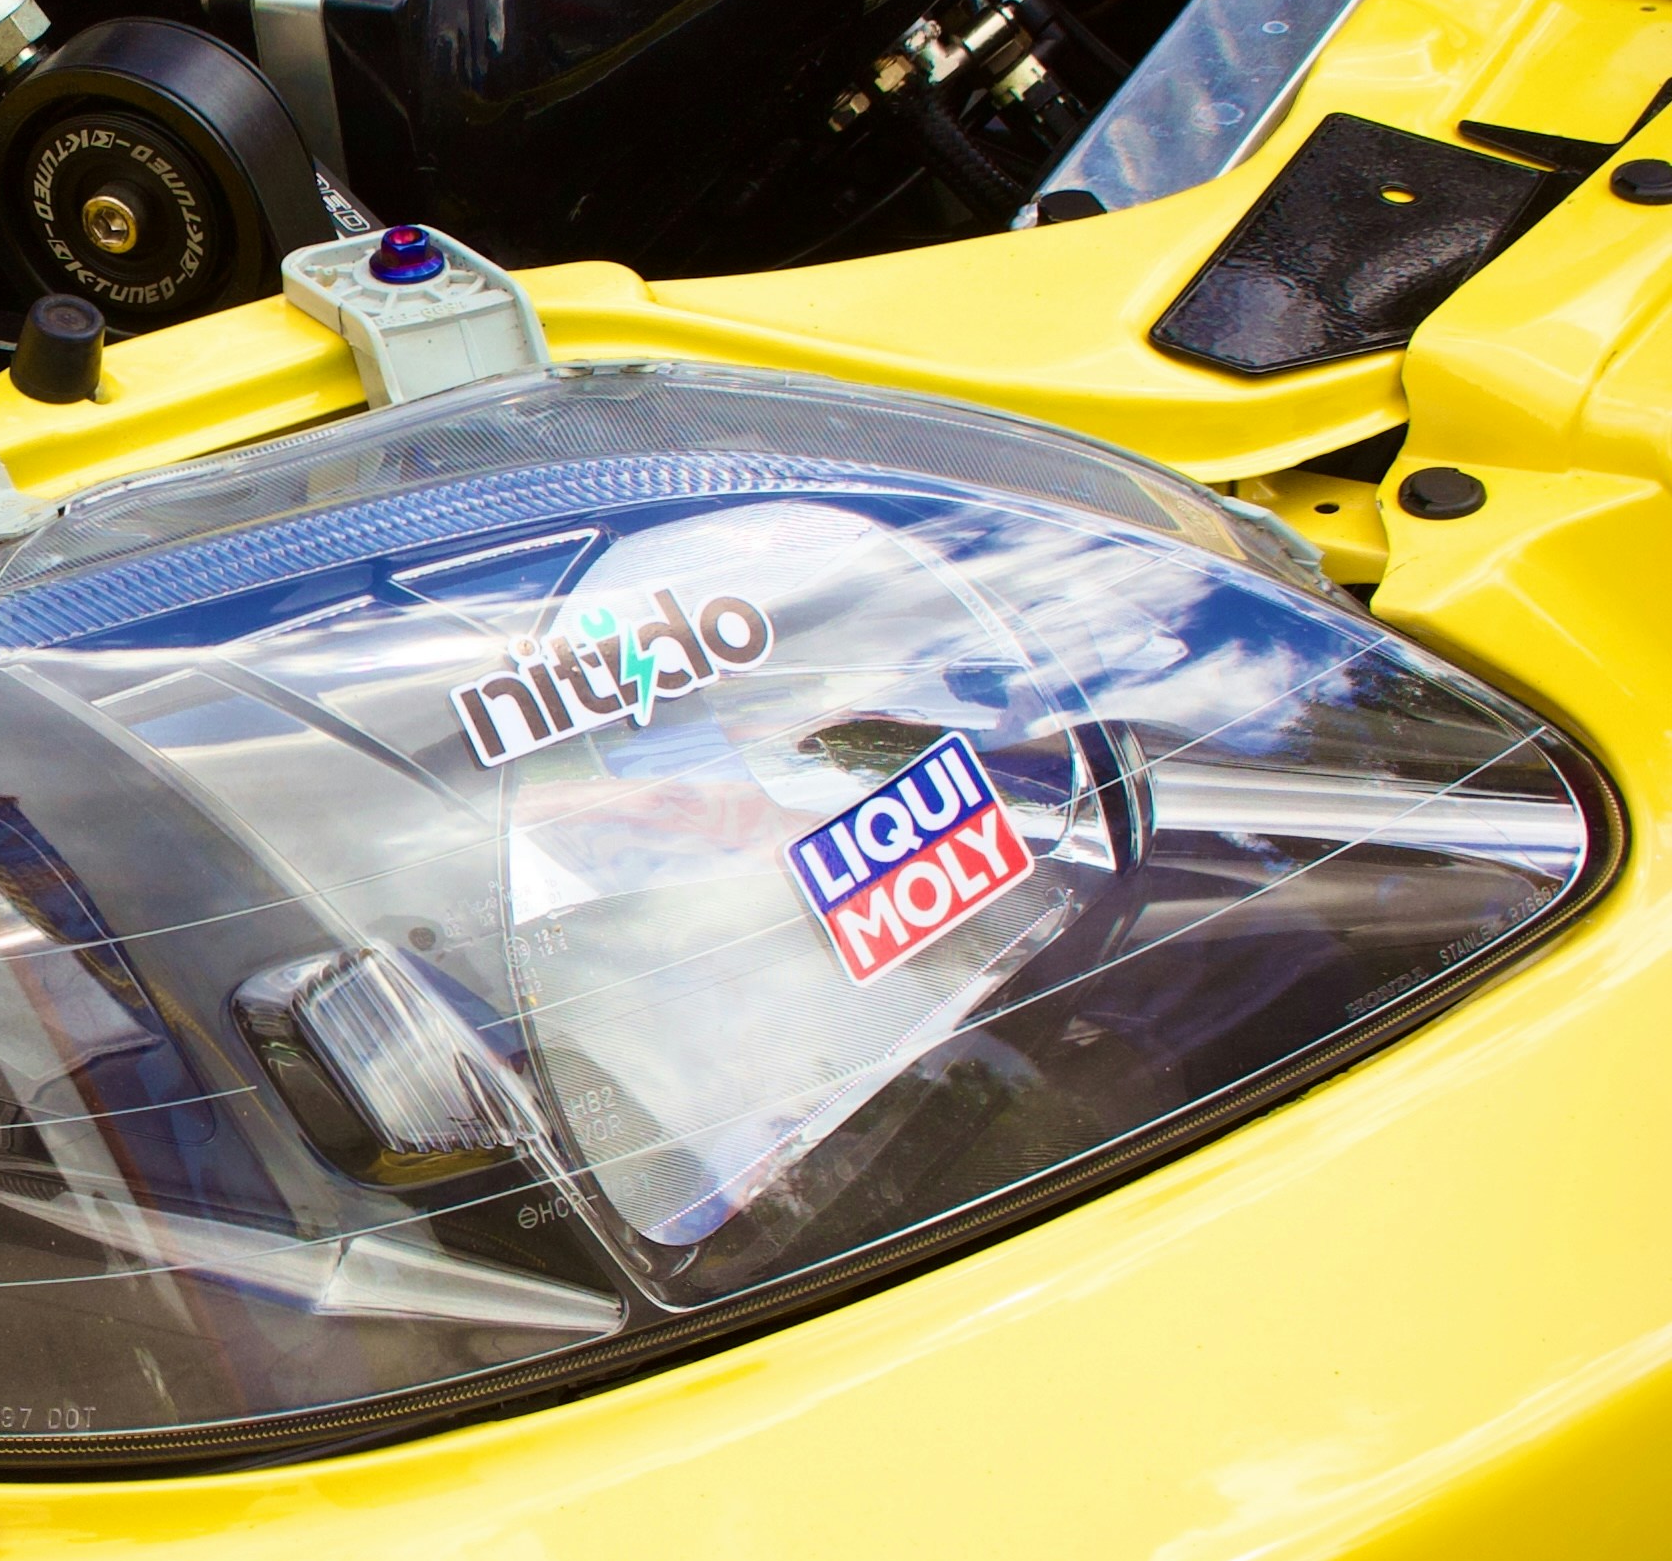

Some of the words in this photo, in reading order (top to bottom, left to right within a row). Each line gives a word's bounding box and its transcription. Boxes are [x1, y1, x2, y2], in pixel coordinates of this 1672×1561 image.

[799, 745, 983, 903] LIQUI
[836, 808, 1016, 970] MOLY
[1344, 965, 1431, 1020] HONDA
[569, 1086, 616, 1119] HB2
[47, 1406, 97, 1429] DOT
